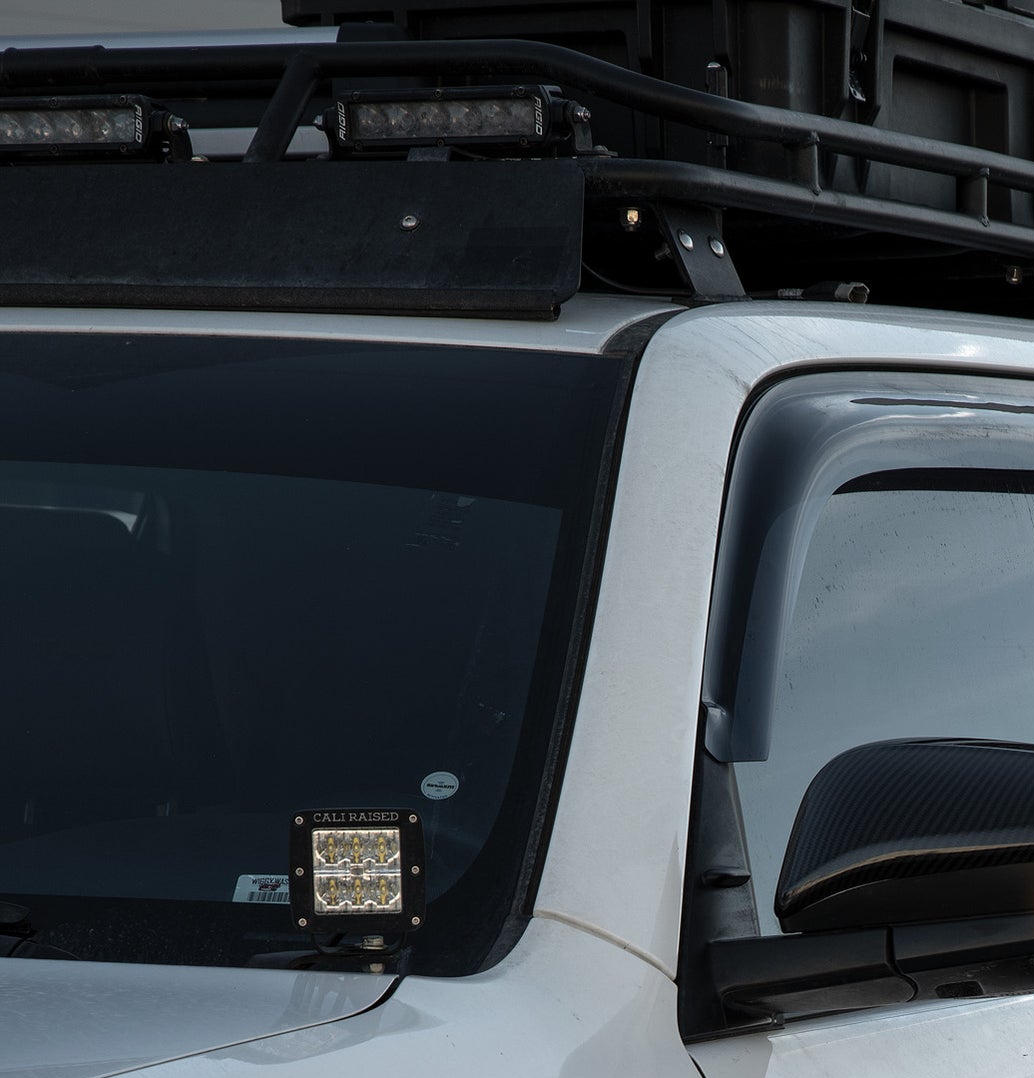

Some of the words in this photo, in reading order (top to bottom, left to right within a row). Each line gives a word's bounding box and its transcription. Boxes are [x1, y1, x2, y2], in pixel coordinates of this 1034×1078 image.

[134, 104, 143, 144] RIGID
[337, 101, 346, 141] RIGID
[534, 96, 543, 136] RIGID
[313, 812, 346, 823] CALI
[349, 811, 399, 822] RAISED
